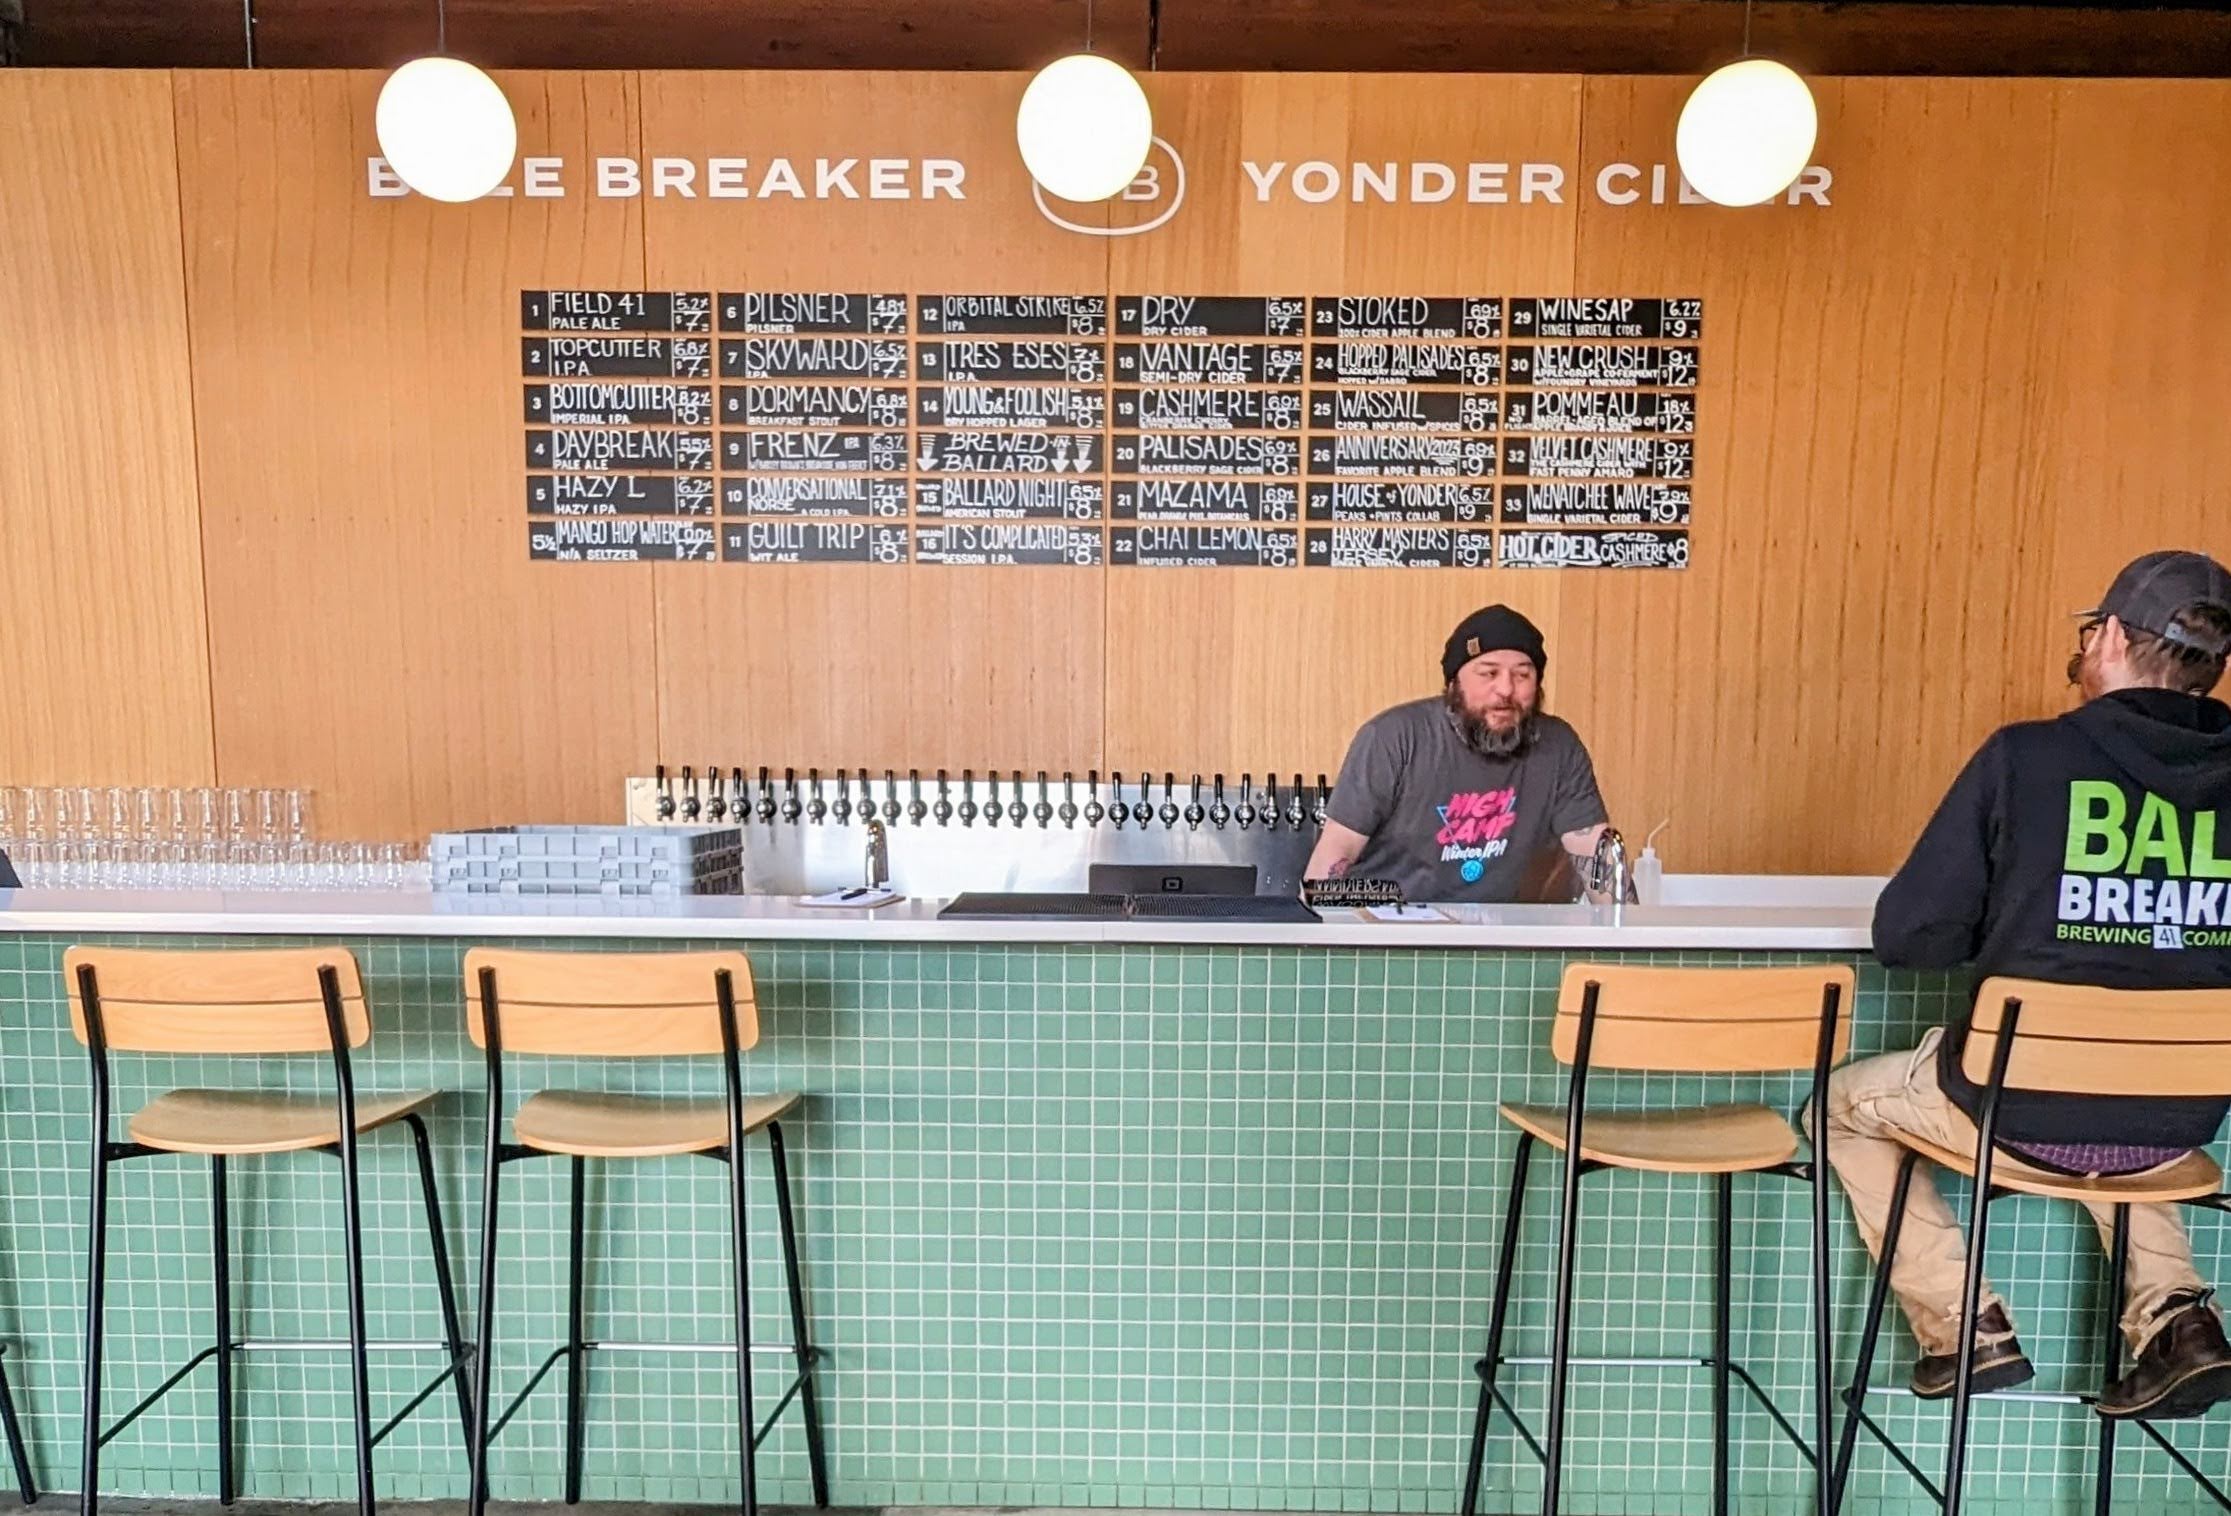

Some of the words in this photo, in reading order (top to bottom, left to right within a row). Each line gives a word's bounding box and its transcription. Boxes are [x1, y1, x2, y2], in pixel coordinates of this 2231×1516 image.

[368, 157, 565, 197] BE
[597, 158, 967, 199] BREAKER
[1242, 161, 1565, 204] YONDER
[1596, 163, 1833, 206] CIR
[551, 292, 612, 314] FIELD
[618, 294, 645, 315] 41
[748, 293, 851, 323] PILSNER
[946, 297, 1013, 317] ORBITAL
[1016, 296, 1068, 318] STRIKE
[727, 307, 737, 318] 6
[923, 309, 937, 321] 12
[1121, 310, 1136, 321] 17
[1144, 297, 1195, 325] DRY
[1339, 297, 1428, 325] STOKED
[1540, 299, 1633, 322] WINESAP
[1317, 311, 1333, 323] 23
[1514, 312, 1531, 324] 29
[552, 318, 588, 330] PALE
[592, 318, 622, 330] ALE
[746, 324, 794, 333] PILSNER
[1542, 324, 1571, 336] SINGLE
[1575, 324, 1611, 336] VARIETAL
[1616, 325, 1642, 336] CIDER
[1144, 327, 1164, 336] DRY
[1171, 327, 1208, 336] CIDER
[1362, 329, 1388, 338] CIDER
[1392, 330, 1418, 338] APPLE
[1423, 329, 1455, 338] BLEND
[551, 339, 662, 358] TOPCUTTER
[747, 339, 868, 370] SKYWARD
[531, 351, 540, 363] 2
[728, 352, 737, 364] 7
[923, 355, 936, 366] 13
[945, 342, 1001, 368] TRES
[1013, 342, 1067, 369] ESES
[1141, 343, 1253, 371] VANTAGE
[1340, 344, 1388, 369] HOPPED
[1393, 344, 1464, 370] PALISADES
[1535, 346, 1573, 369] NEW
[1579, 346, 1648, 370] CRUSH
[1120, 357, 1134, 369] 18
[1315, 357, 1333, 369] 24
[1511, 359, 1528, 371] 30
[1141, 372, 1202, 383] SEMI-DRY
[1209, 373, 1246, 383] CIDER
[552, 385, 675, 410] BOTTOMCUTTER
[750, 387, 871, 413] DORMANCY
[1141, 389, 1259, 417] CASHMERE
[532, 398, 542, 410] 3
[728, 399, 738, 411] 8
[923, 401, 938, 412] 14
[1119, 403, 1134, 415] 19
[1314, 403, 1331, 415] 25
[1338, 390, 1426, 419] WASSAIL
[1535, 392, 1638, 417] POMMEAU
[1512, 405, 1525, 416] 31
[552, 414, 605, 424] IMPERIAL
[749, 417, 803, 425] BREAKFAST
[809, 417, 841, 426] STOUT
[945, 418, 965, 426] DRY
[967, 418, 1007, 427] HOPPED
[1010, 418, 1046, 427] LAGER
[1336, 421, 1368, 430] CIDER
[1372, 422, 1416, 430] INFUSED
[554, 431, 673, 459] DAYBREAK
[729, 443, 739, 455] 9
[752, 433, 840, 458] FRENZ
[945, 433, 1048, 453] BREWED
[1140, 435, 1263, 461] PALISADES
[1336, 436, 1433, 460] ANNIVERSARY
[1430, 439, 1460, 456] 2023
[1531, 438, 1577, 460] VELVET
[1581, 437, 1652, 461] CASHMERE
[534, 444, 545, 455] 4
[1117, 448, 1134, 460] 20
[1313, 450, 1330, 462] 26
[1508, 451, 1525, 462] 32
[554, 459, 580, 470] PALE
[585, 459, 609, 470] ALE
[942, 454, 1048, 472] BALLARD
[1140, 465, 1206, 474] BLACKBERRY
[1209, 466, 1234, 474] SAGE
[1237, 466, 1263, 474] CIDER
[1336, 467, 1379, 476] FAVORITE
[1384, 467, 1414, 476] APPLE
[1420, 467, 1456, 476] BLEND
[1530, 468, 1555, 477] FAST
[1558, 468, 1590, 477] PENNY
[1594, 468, 1634, 477] AMARO
[555, 476, 619, 498] HAZY
[627, 476, 645, 497] L
[749, 478, 867, 500] CONVERSATIONAL
[945, 479, 1014, 507] BALLARD
[1019, 479, 1066, 507] NIGHT
[536, 489, 546, 500] 5
[727, 491, 742, 502] 10
[923, 493, 937, 503] 15
[1117, 495, 1131, 506] 21
[1139, 481, 1248, 509] MAZAMA
[1336, 484, 1385, 508] HOUSE
[1399, 483, 1456, 507] YONDER
[1529, 484, 1608, 510] WENATCHEE
[1613, 484, 1651, 510] WAVE
[750, 500, 795, 511] NORSE
[1312, 496, 1328, 507] 27
[1506, 500, 1522, 511] 33
[555, 505, 588, 514] HAZY
[944, 509, 990, 518] AMERICAN
[993, 509, 1026, 518] STOUT
[1336, 512, 1366, 521] PEAKS
[1407, 512, 1440, 521] COLLAB
[1528, 514, 1561, 523] SINGLE
[1565, 514, 1607, 523] VARIETAL
[1610, 514, 1641, 523] CIDER
[558, 521, 607, 543] MANGO
[612, 521, 638, 544] HOP
[640, 521, 677, 544] WATER
[751, 523, 809, 548] GUILT
[814, 523, 864, 548] TRIP
[946, 525, 976, 549] IT'S
[982, 525, 1066, 549] COMPLICATED
[1139, 527, 1190, 550] CHAI
[1198, 527, 1260, 550] LEMON
[729, 536, 741, 547] 11
[922, 539, 937, 550] 16
[1334, 528, 1377, 550] HARRY
[1116, 540, 1132, 552] 22
[1311, 541, 1327, 553] 28
[1499, 535, 1537, 559] HOT
[1541, 535, 1599, 559] CIDER
[1601, 543, 1666, 561] CASHMERE
[558, 549, 581, 560] N/A
[587, 550, 638, 560] SELTZER
[776, 553, 799, 561] ALE
[943, 554, 985, 564] SESSION
[1332, 549, 1404, 560] JERSEY
[1446, 788, 1514, 817] HIGH
[1436, 812, 1515, 844] CAMP
[1483, 839, 1508, 858] IPA
[2056, 924, 2151, 944] BREWING
[2160, 928, 2176, 945] 41
